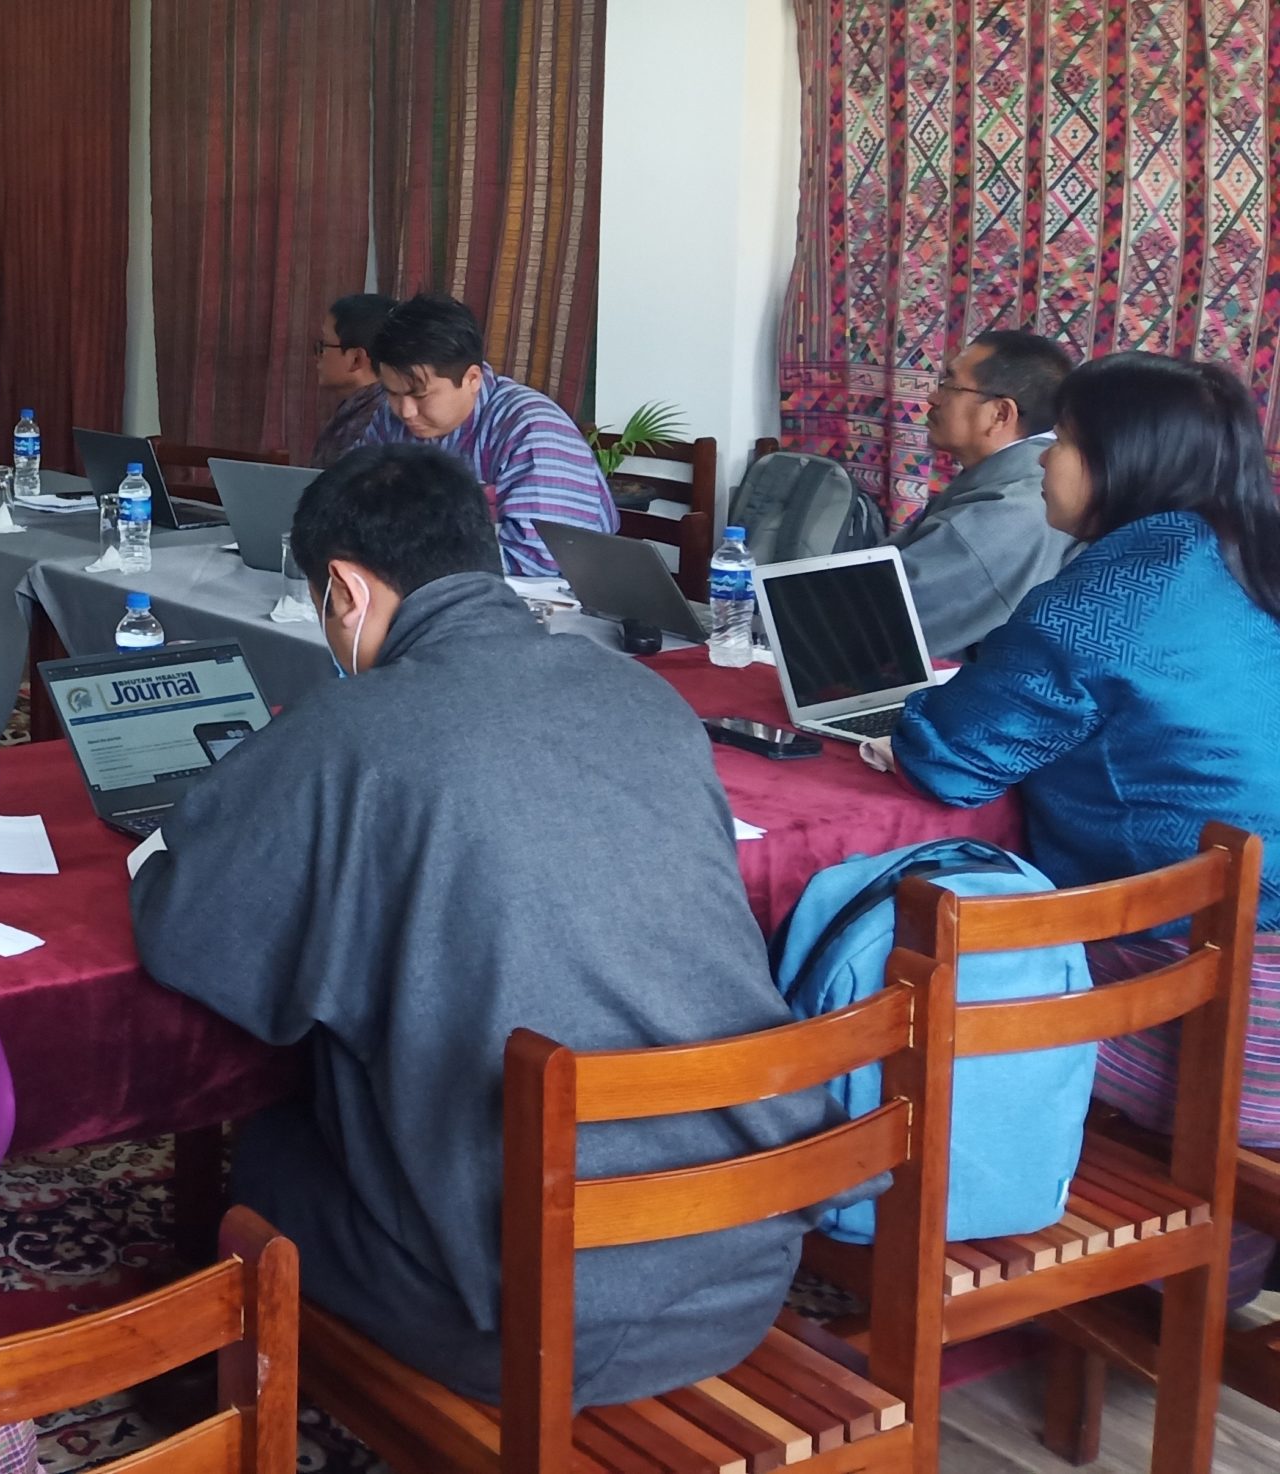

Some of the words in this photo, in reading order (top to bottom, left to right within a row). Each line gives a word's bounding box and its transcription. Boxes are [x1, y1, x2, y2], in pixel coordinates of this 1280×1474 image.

[110, 671, 201, 705] Journal
[118, 676, 153, 686] BHUTAN
[155, 672, 188, 682] HEALTH
